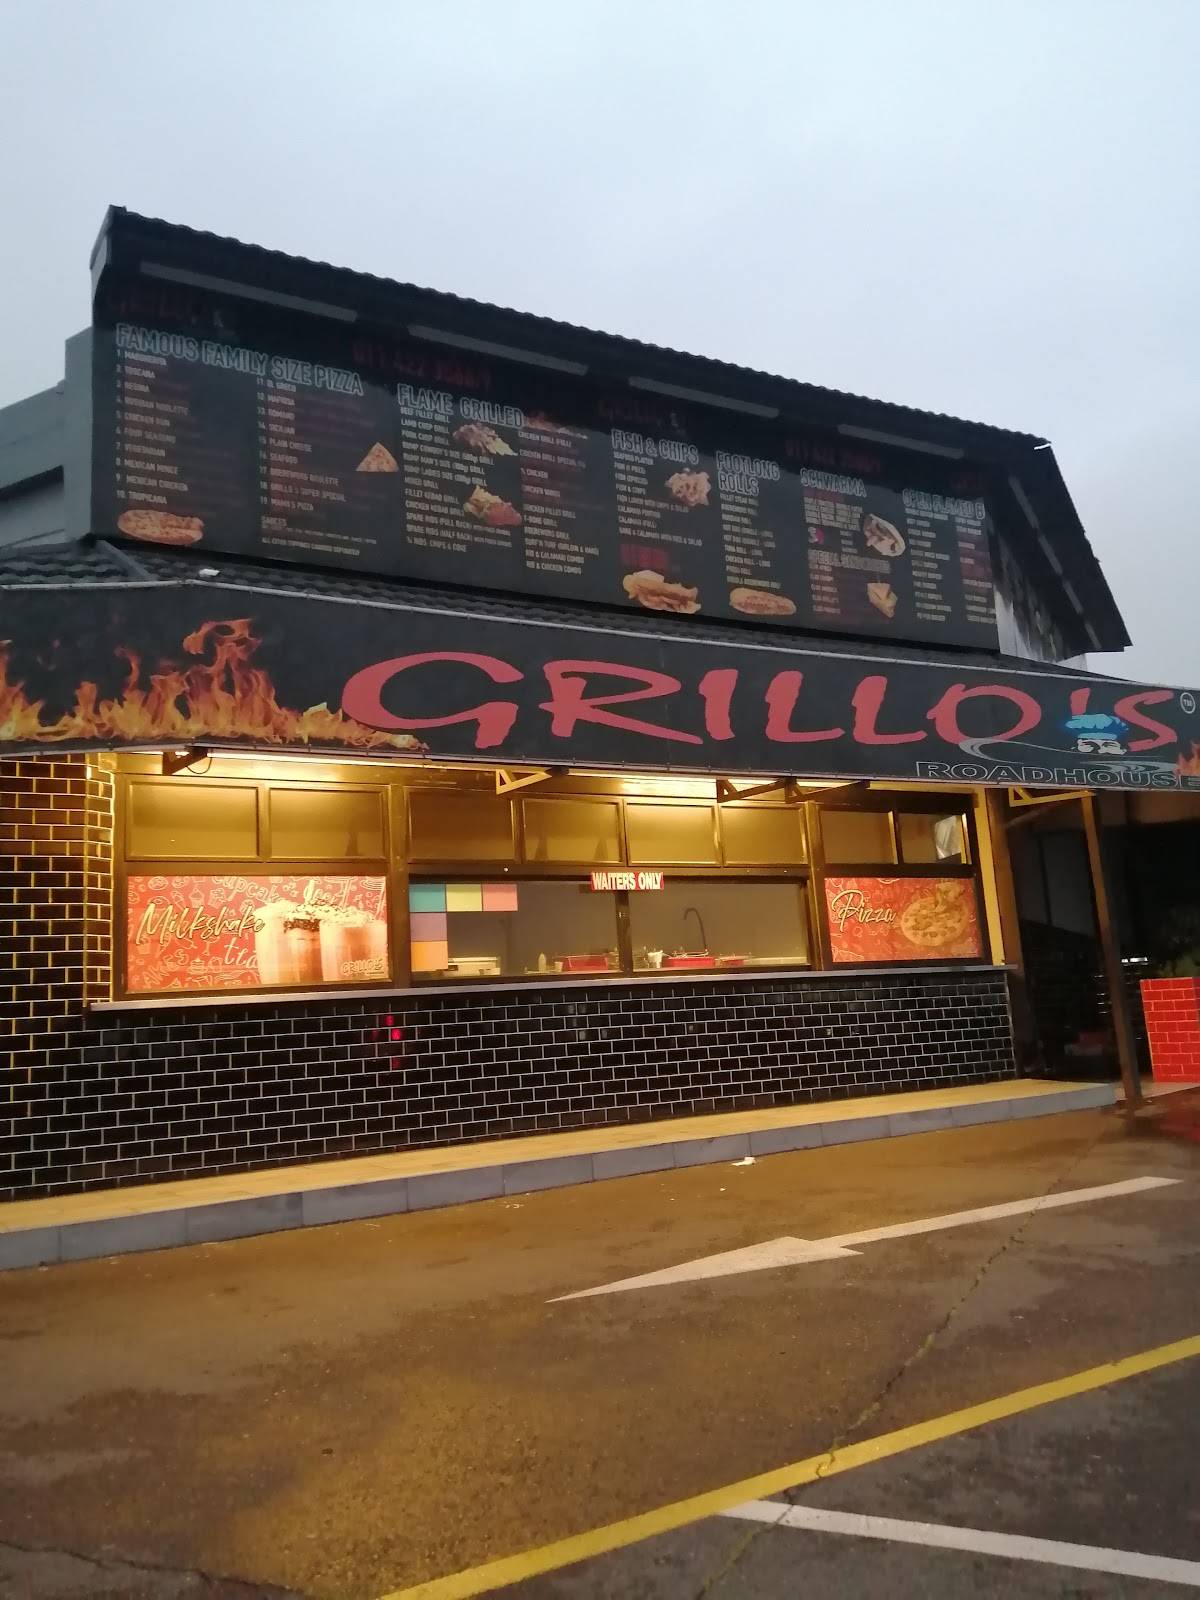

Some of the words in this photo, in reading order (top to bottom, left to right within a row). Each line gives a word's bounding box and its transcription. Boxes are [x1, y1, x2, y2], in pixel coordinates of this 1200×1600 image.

[116, 322, 199, 362] FAMOUS
[201, 340, 268, 376] FAMILY
[271, 355, 313, 386] SIZE
[314, 364, 364, 397] PIZZA
[397, 382, 454, 417] FLAME
[459, 396, 526, 431] GRILLED
[611, 428, 644, 456] FISH
[645, 436, 658, 459] &
[659, 438, 699, 466] CHIPS
[715, 449, 781, 482] FOOTLONG
[717, 469, 760, 498] ROLLS
[341, 651, 1178, 753] GRILLO'S
[591, 872, 637, 891] WAITERS
[637, 872, 664, 891] ONLY
[135, 901, 267, 946] Milkshake
[831, 888, 897, 933] Pizza
